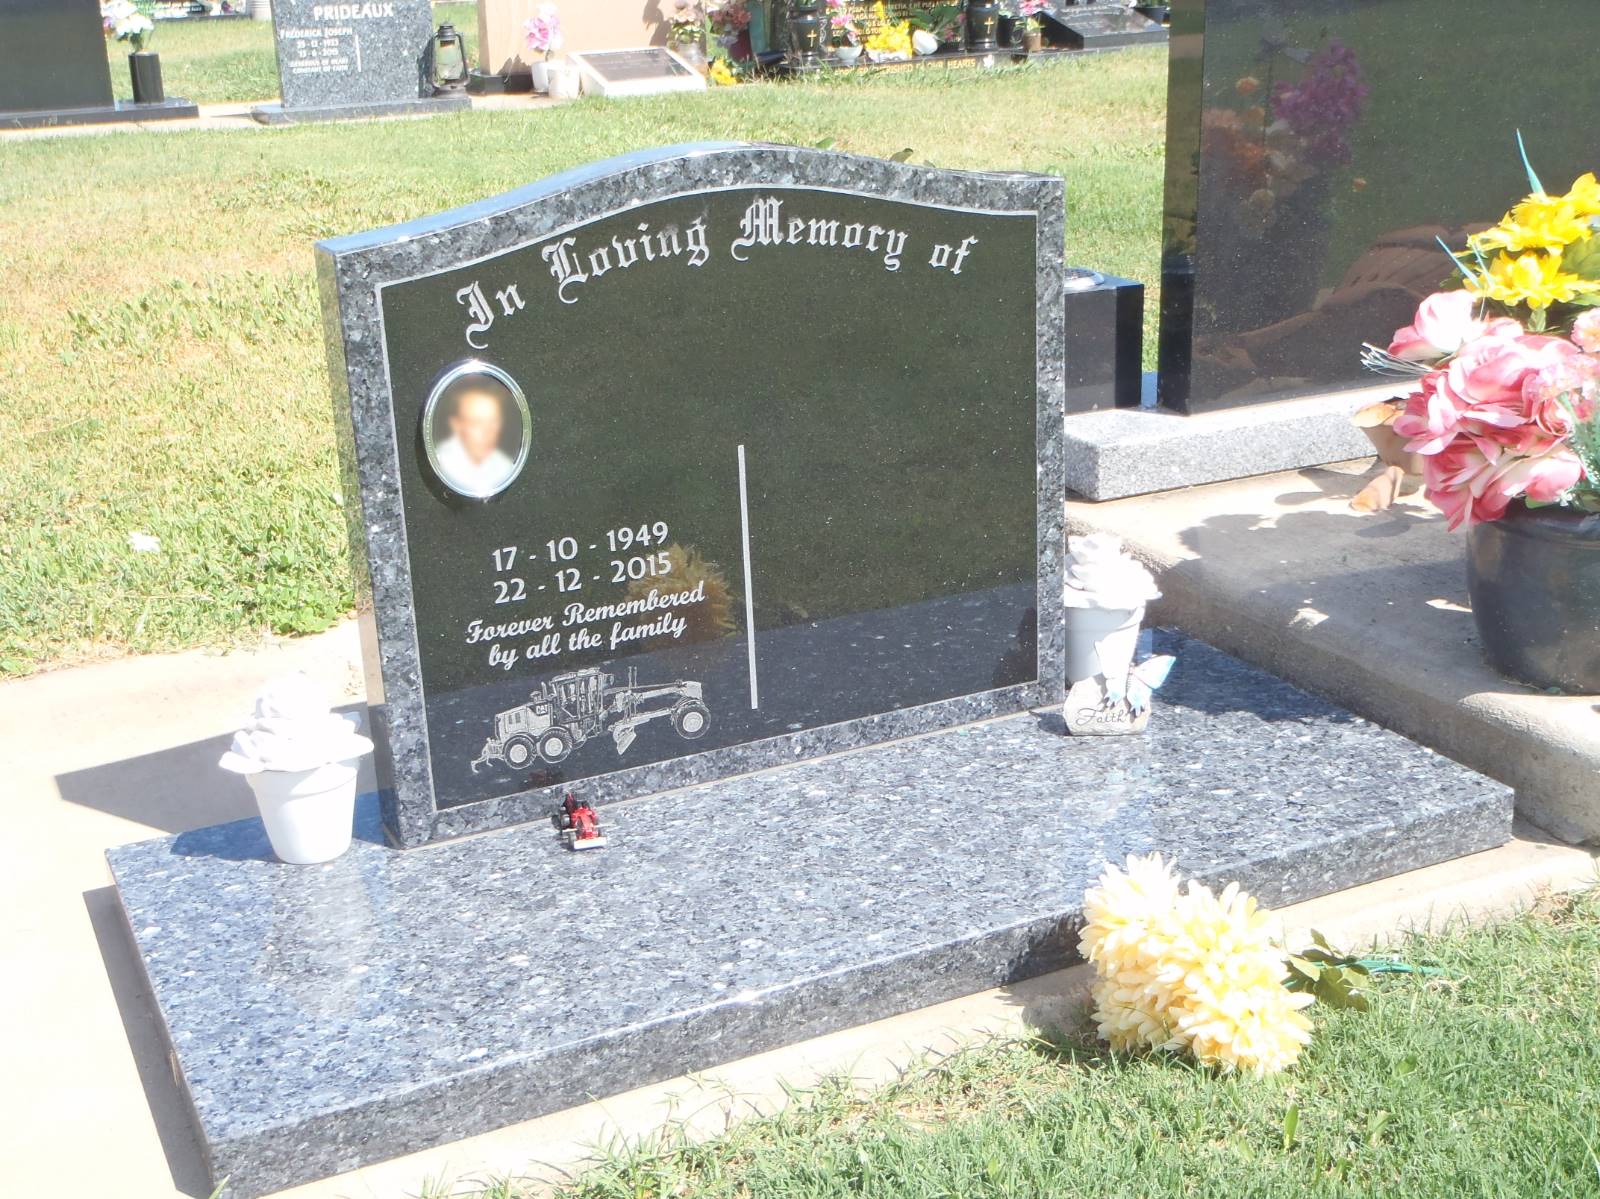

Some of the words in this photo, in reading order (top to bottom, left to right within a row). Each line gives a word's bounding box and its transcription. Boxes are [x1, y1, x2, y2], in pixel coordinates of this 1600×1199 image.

[313, 3, 395, 21] PRIDEAUX
[948, 58, 977, 70] HEARTS
[456, 280, 526, 350] In
[541, 216, 710, 304] Loving
[731, 195, 908, 272] Memory
[928, 235, 979, 275] of
[492, 546, 518, 572] 17
[546, 536, 578, 562] 10
[606, 521, 669, 552] 1949
[493, 577, 527, 604] 22
[555, 568, 583, 592] 12
[610, 552, 672, 583] 2015
[466, 615, 554, 644] Forever
[562, 580, 706, 627] Remembered
[488, 644, 519, 671] by
[526, 632, 561, 660] all
[568, 628, 602, 651] the
[610, 612, 687, 650] family
